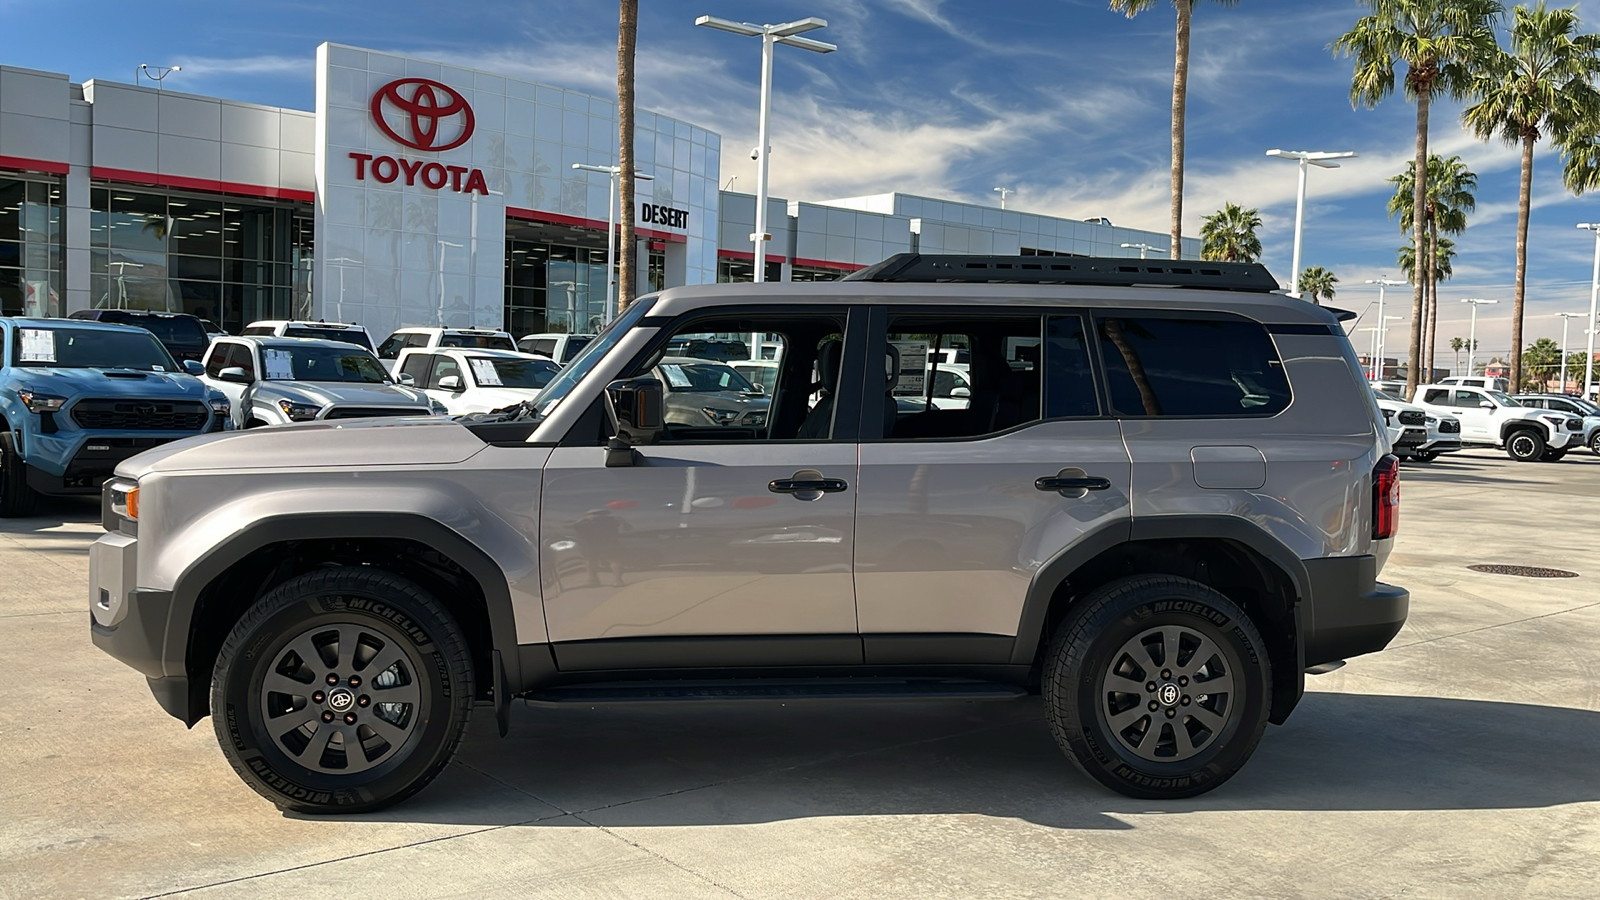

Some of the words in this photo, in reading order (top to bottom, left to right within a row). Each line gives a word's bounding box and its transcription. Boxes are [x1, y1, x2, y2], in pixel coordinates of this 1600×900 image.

[348, 152, 489, 196] TOYOTA
[642, 203, 689, 229] DESERT
[348, 597, 428, 643] MICHELIN
[1154, 600, 1227, 624] MICHELIN
[433, 653, 448, 679] 265/70
[228, 708, 237, 730] TRAIL
[232, 732, 244, 748] LTX
[252, 761, 329, 803] MICHELIN
[1117, 766, 1190, 788] MICHELIN
